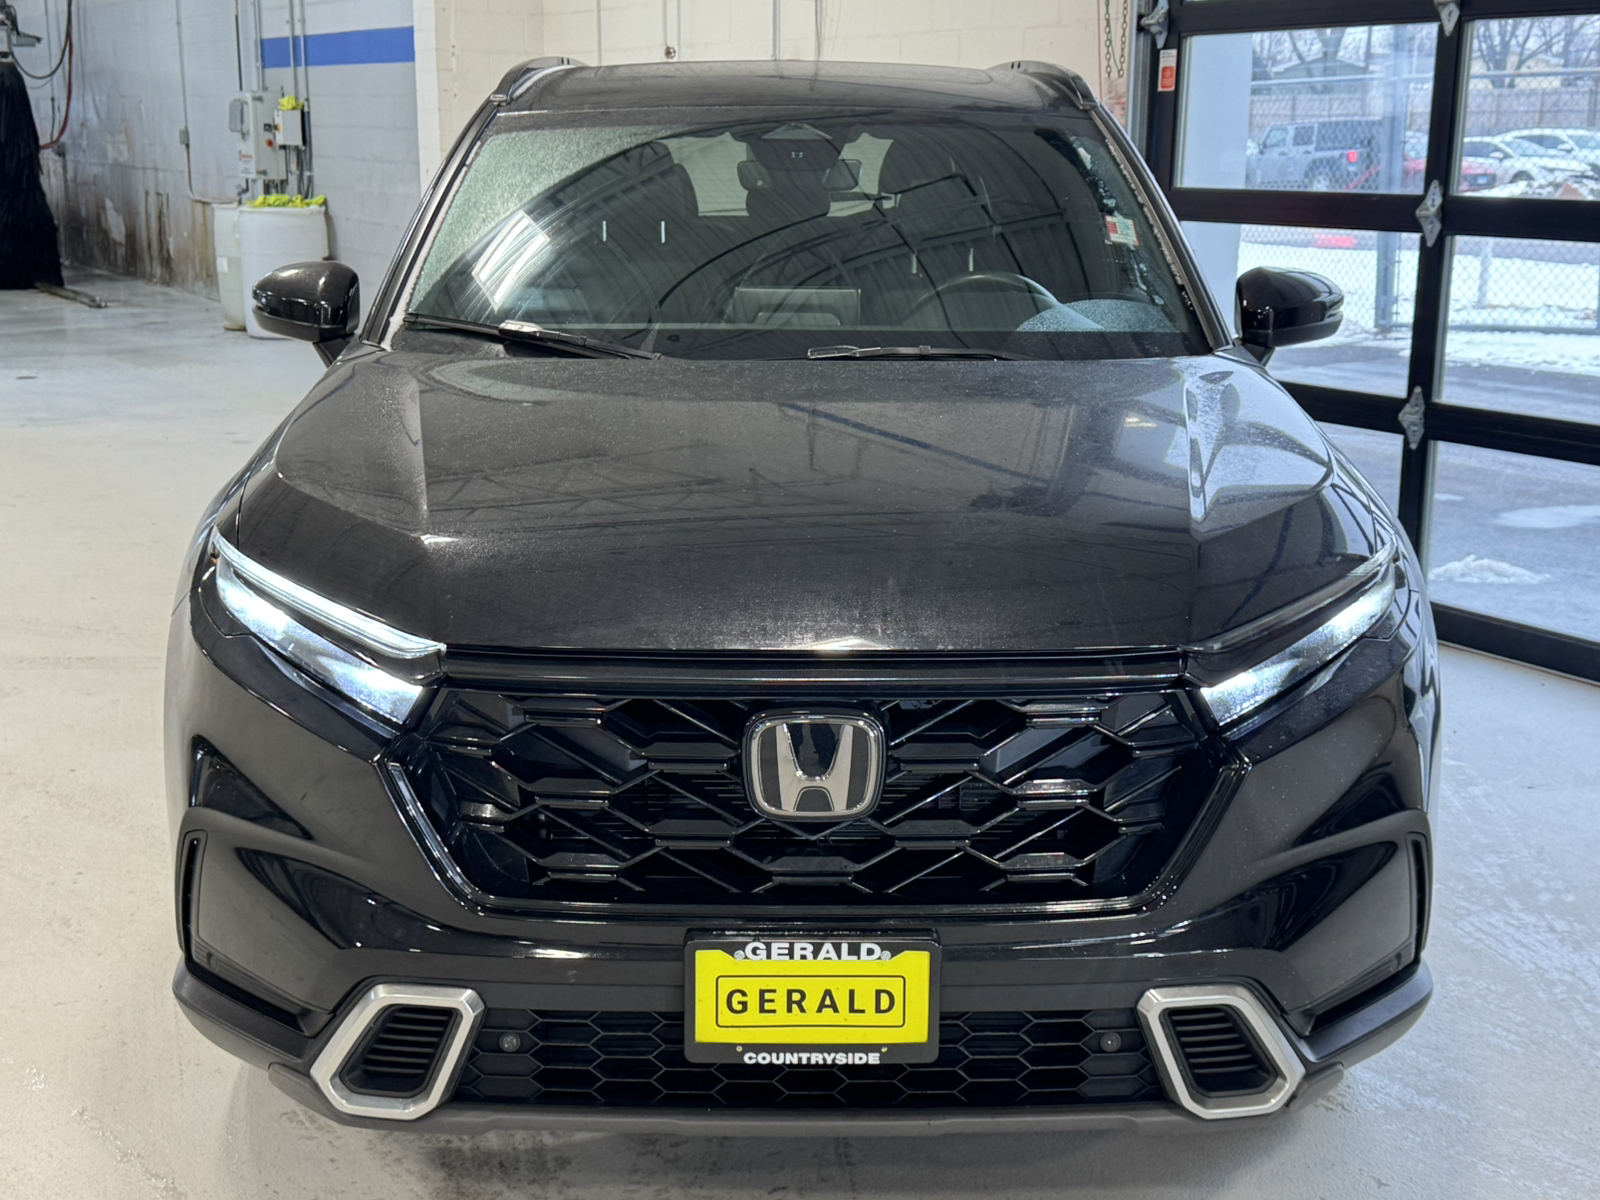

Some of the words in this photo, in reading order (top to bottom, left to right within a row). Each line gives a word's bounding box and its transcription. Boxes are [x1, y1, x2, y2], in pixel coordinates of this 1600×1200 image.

[744, 941, 882, 960] GERALD
[726, 989, 896, 1014] GERALD
[743, 1052, 880, 1064] COUNTRYSIDE
